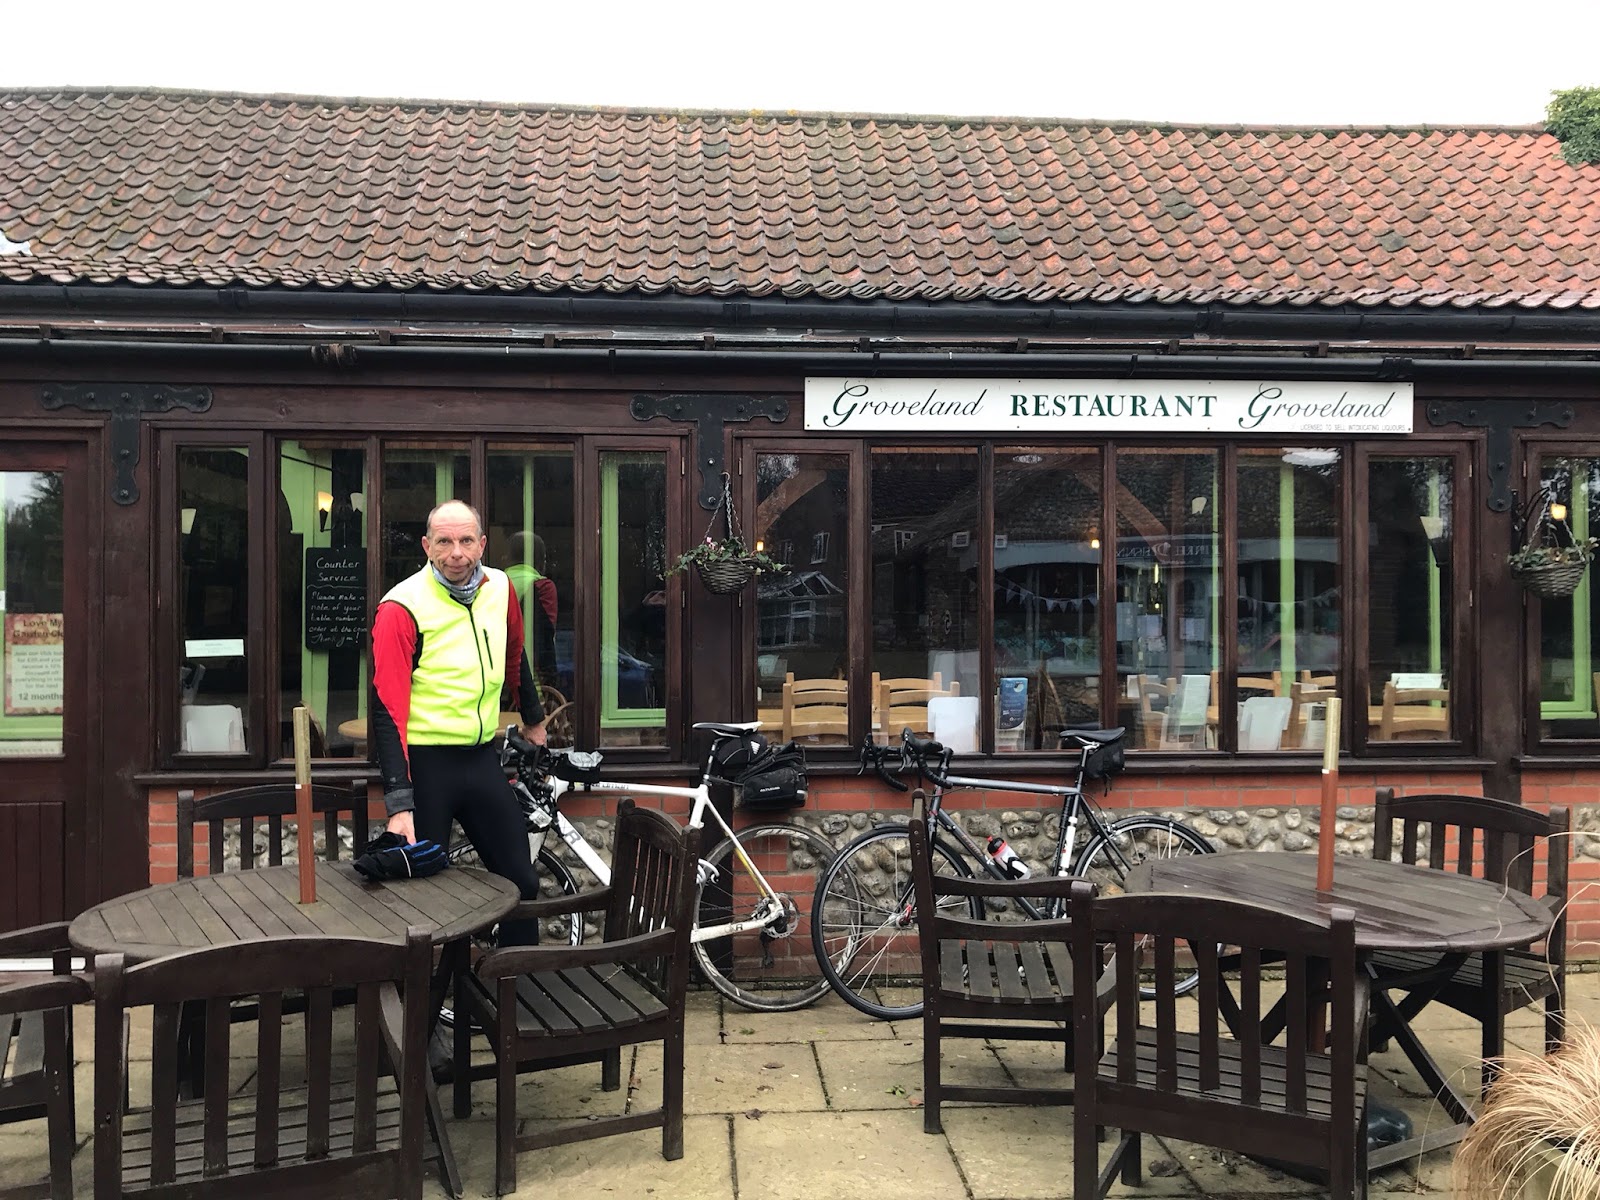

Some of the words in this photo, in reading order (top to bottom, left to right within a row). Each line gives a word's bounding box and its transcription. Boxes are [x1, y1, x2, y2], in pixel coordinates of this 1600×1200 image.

[823, 380, 987, 427] Groveland
[1009, 394, 1218, 417] RESTAURANT
[1238, 383, 1396, 429] Groveland
[316, 557, 360, 569] Counter
[317, 572, 359, 582] Service
[23, 619, 47, 627] Love
[19, 692, 29, 700] 12
